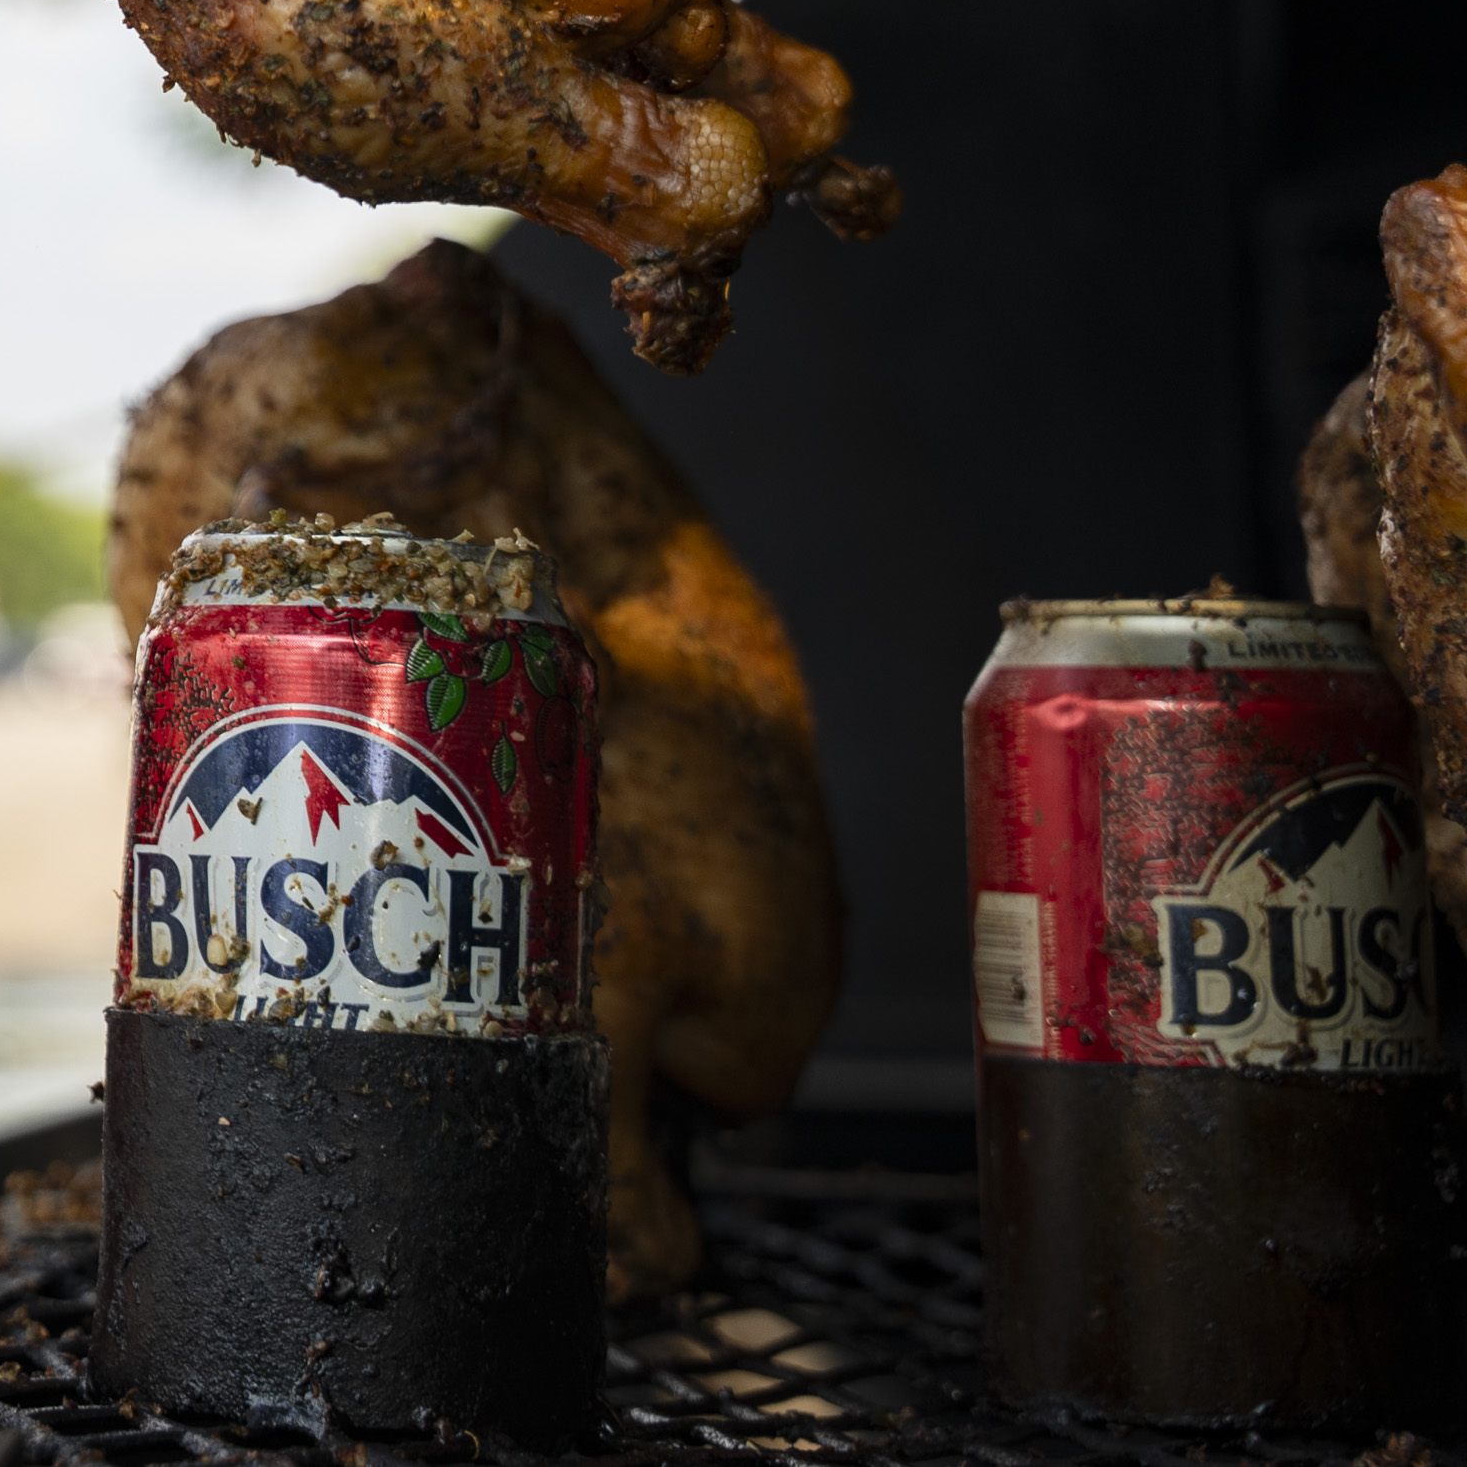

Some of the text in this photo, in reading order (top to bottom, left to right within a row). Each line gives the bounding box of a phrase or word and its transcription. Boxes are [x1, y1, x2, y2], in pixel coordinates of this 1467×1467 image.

[135, 851, 526, 1007] BUSCH
[1169, 905, 1437, 1026] BUS
[233, 985, 370, 1031] LIHT
[1340, 1038, 1420, 1069] LIGH
